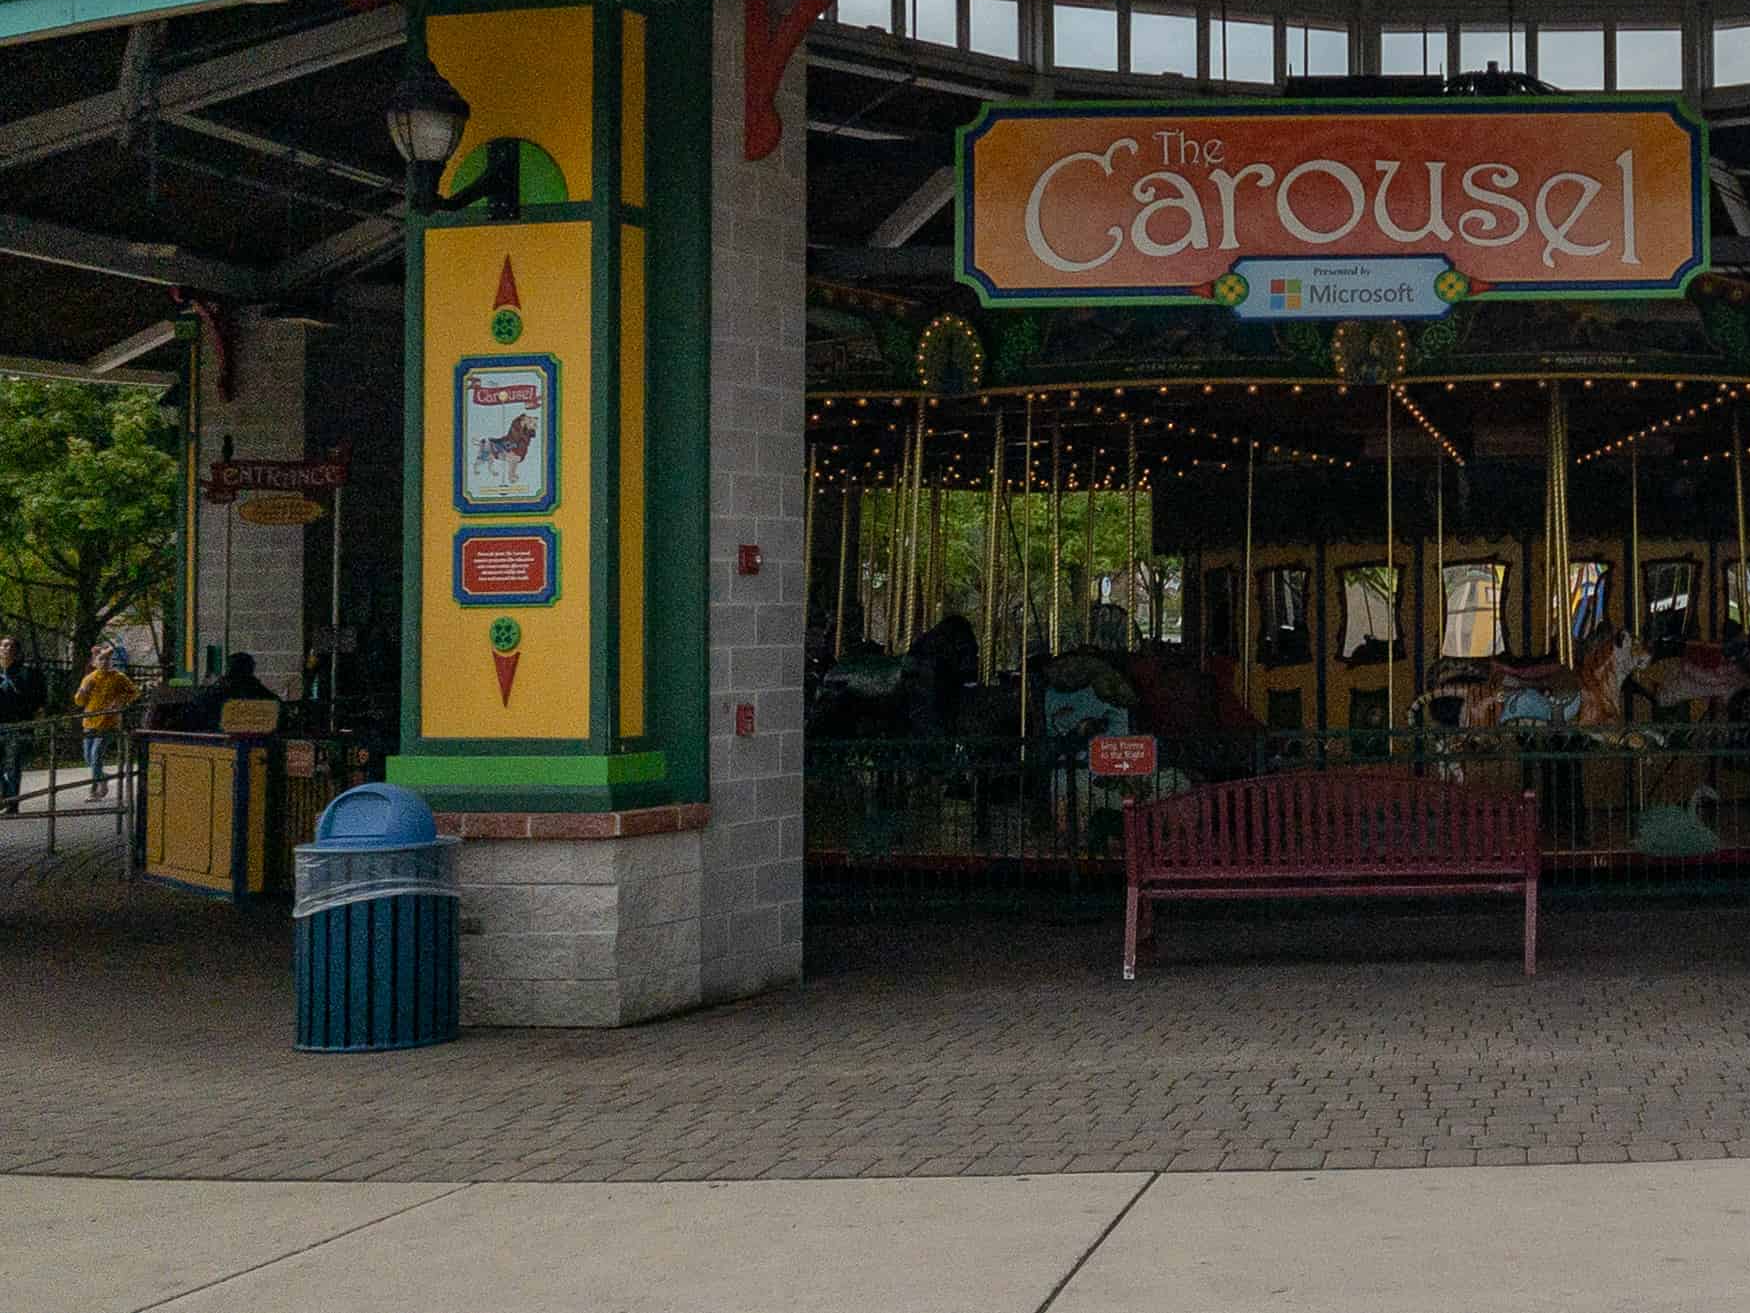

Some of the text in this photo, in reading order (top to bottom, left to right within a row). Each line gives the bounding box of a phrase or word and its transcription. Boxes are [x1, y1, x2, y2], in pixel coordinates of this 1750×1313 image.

[1154, 130, 1225, 165] The
[1025, 137, 1641, 272] Carousel
[1313, 267, 1371, 277] Presented by
[1310, 282, 1415, 304] Microsoft
